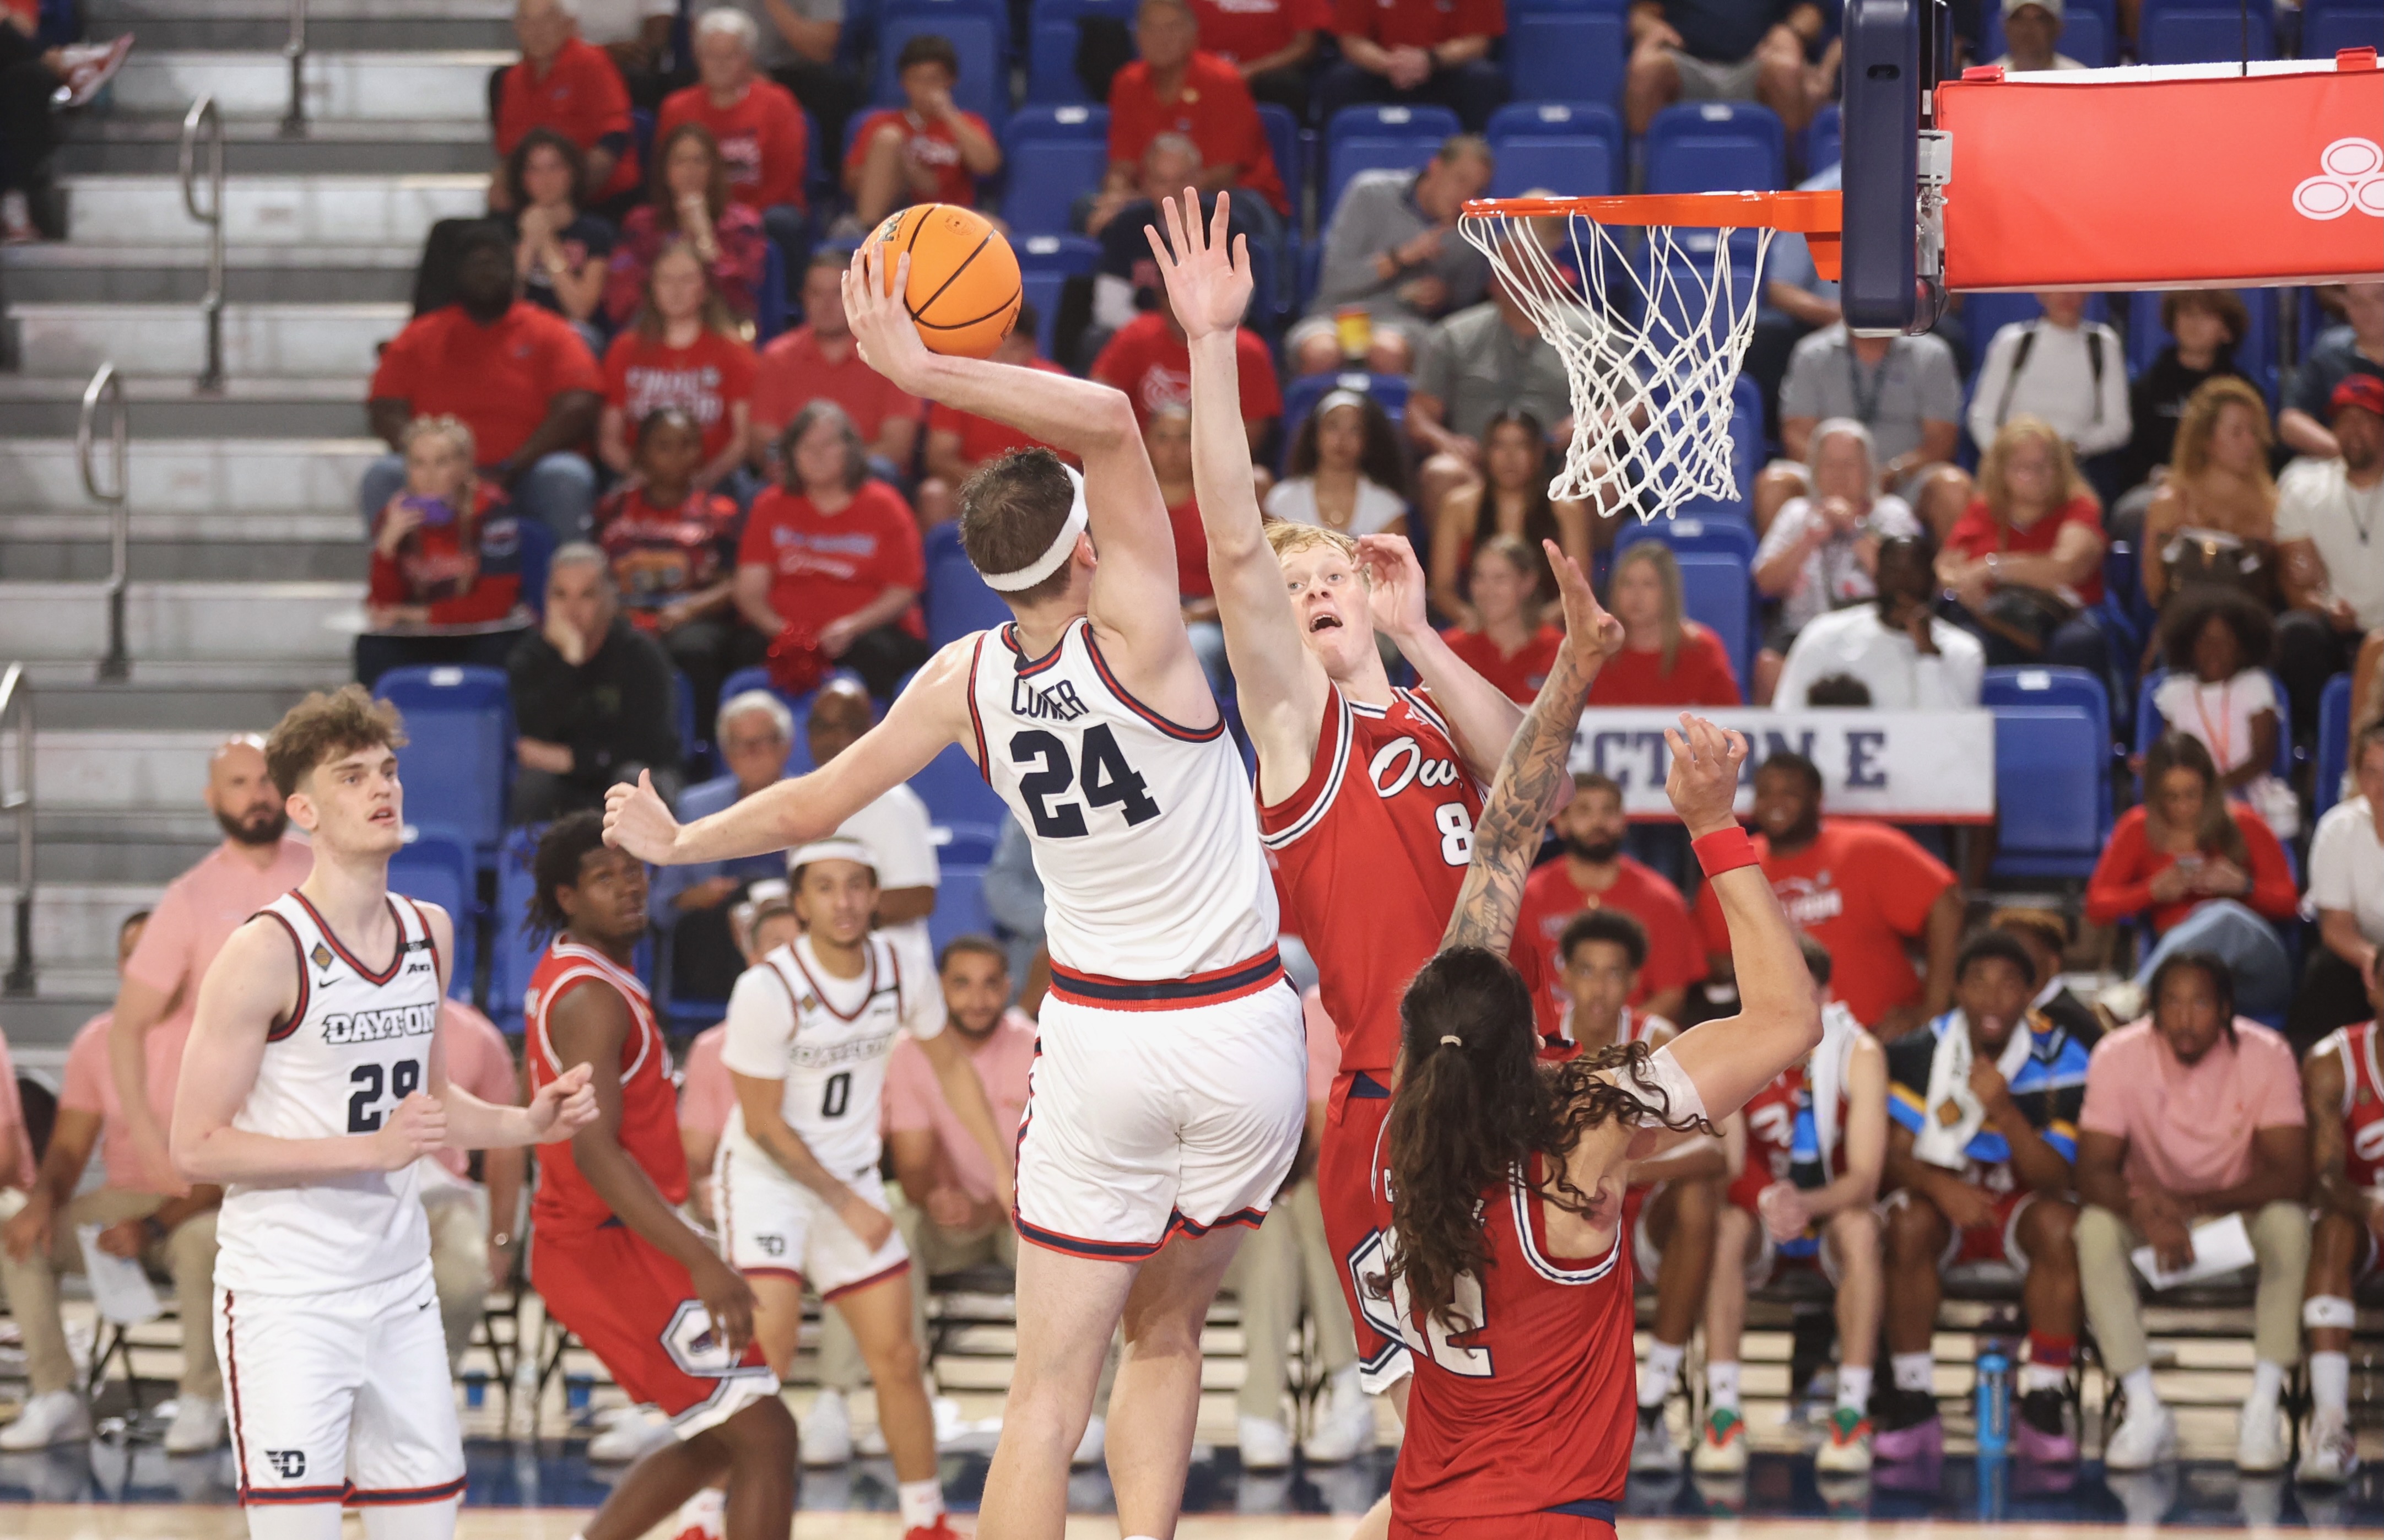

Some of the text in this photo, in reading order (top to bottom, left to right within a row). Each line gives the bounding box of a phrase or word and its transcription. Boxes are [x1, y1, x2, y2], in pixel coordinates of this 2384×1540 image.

[1009, 722, 1163, 839] 24
[1846, 732, 1884, 786] E
[1435, 802, 1474, 867] 8
[322, 1002, 436, 1045] DAYTON
[821, 1072, 851, 1117] 0
